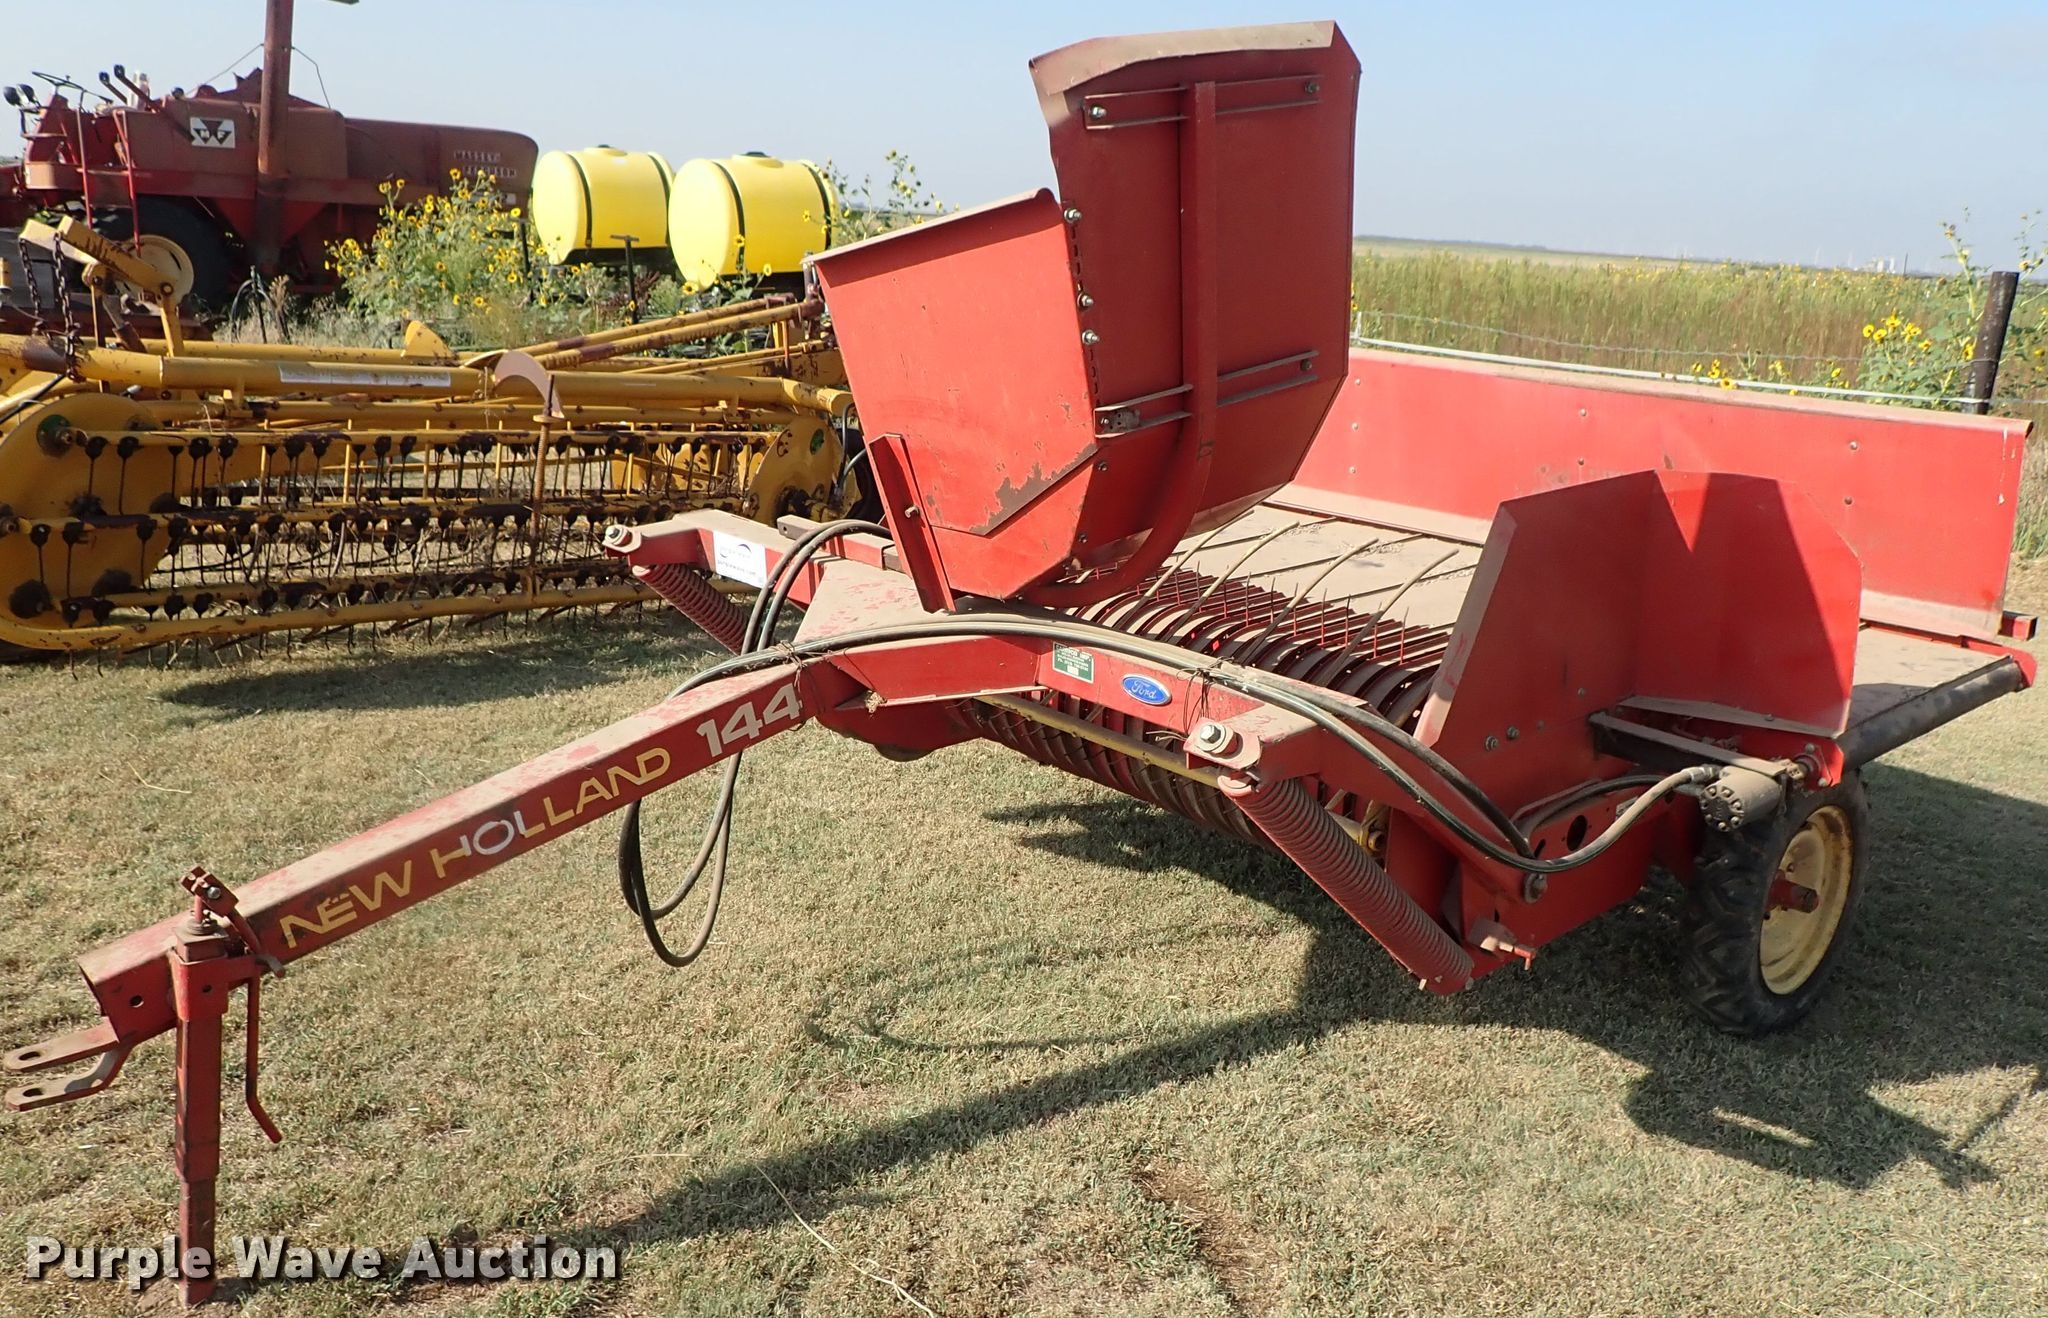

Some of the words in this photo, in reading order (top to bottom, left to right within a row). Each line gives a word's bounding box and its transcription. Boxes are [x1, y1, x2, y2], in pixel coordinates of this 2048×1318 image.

[1131, 680, 1158, 699] Ford
[280, 860, 412, 949] NEW
[430, 747, 671, 879] HOLLAND
[696, 682, 801, 758] 144
